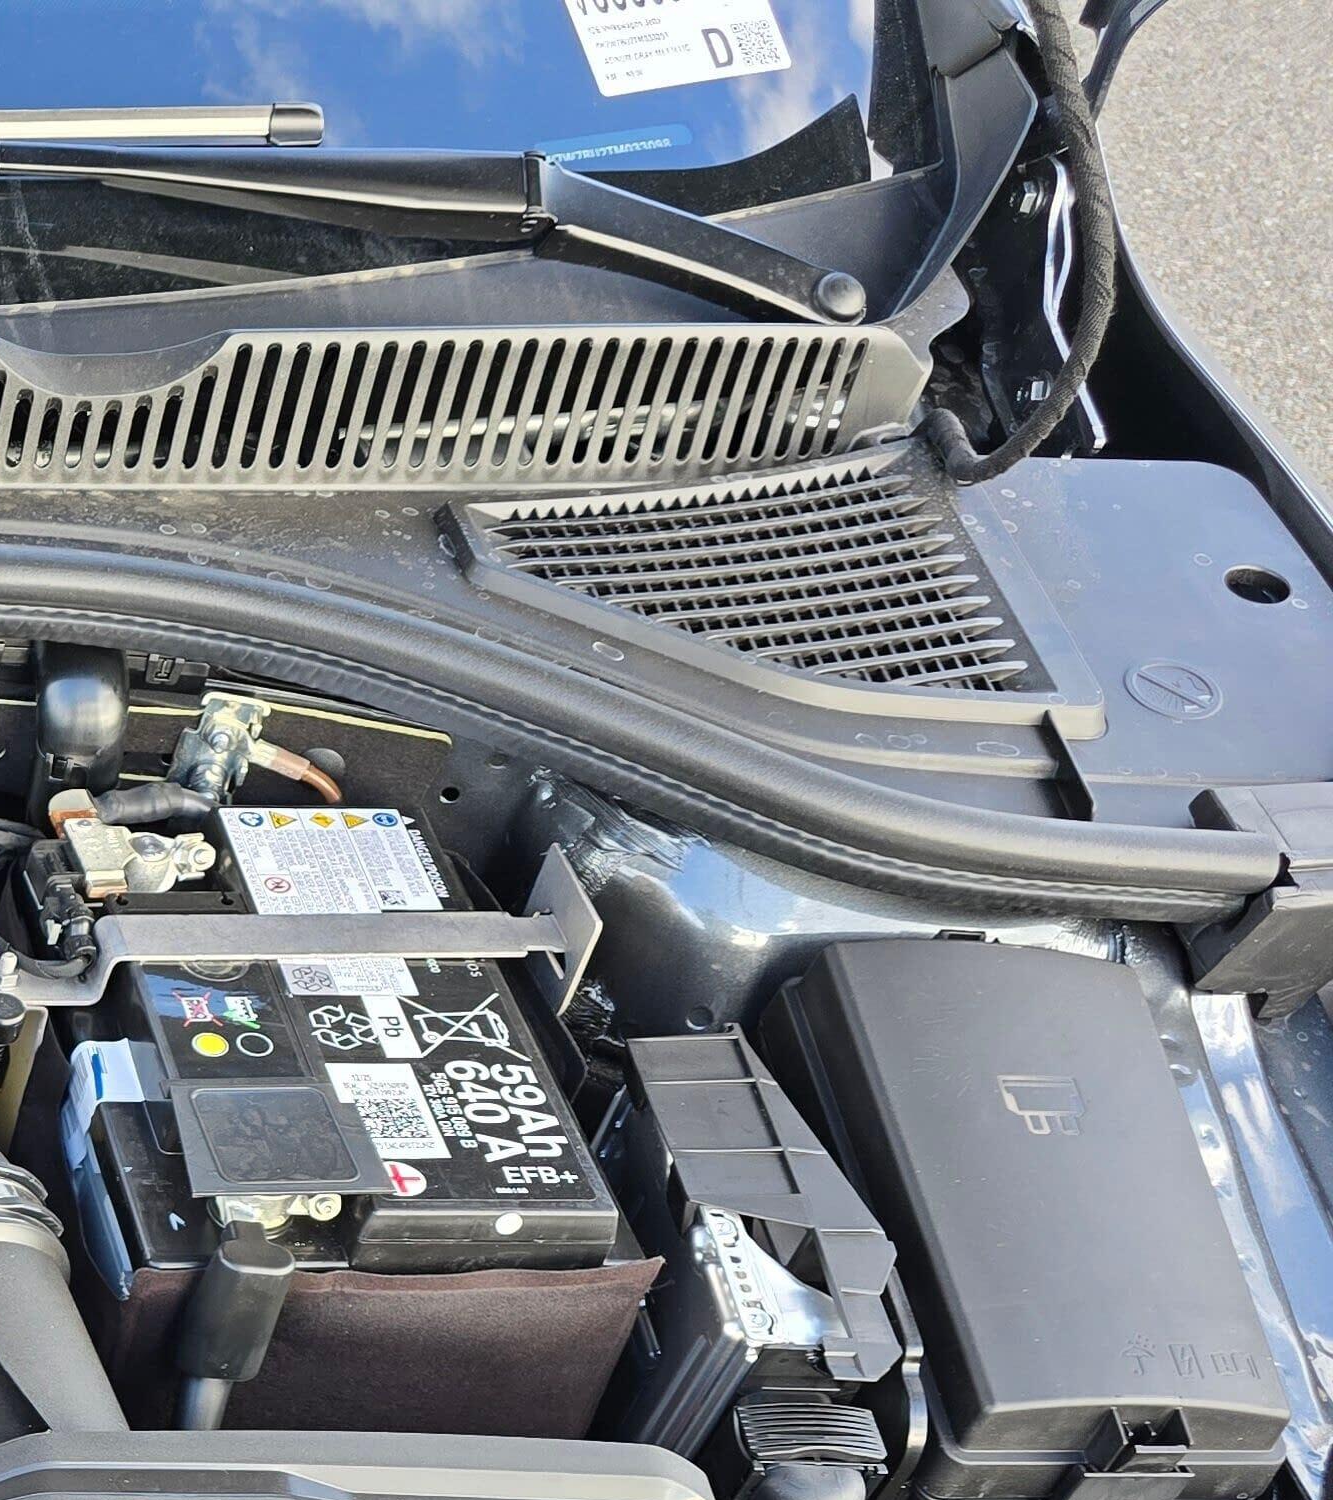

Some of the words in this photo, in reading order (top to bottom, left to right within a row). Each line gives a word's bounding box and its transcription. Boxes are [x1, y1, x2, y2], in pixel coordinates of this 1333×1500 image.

[701, 28, 733, 68] D
[379, 1017, 406, 1037] Pb
[445, 1060, 510, 1124] 640
[490, 1064, 568, 1157] 59Ah
[460, 1140, 478, 1149] B
[476, 1134, 526, 1162] A
[502, 1166, 579, 1184] EFB+
